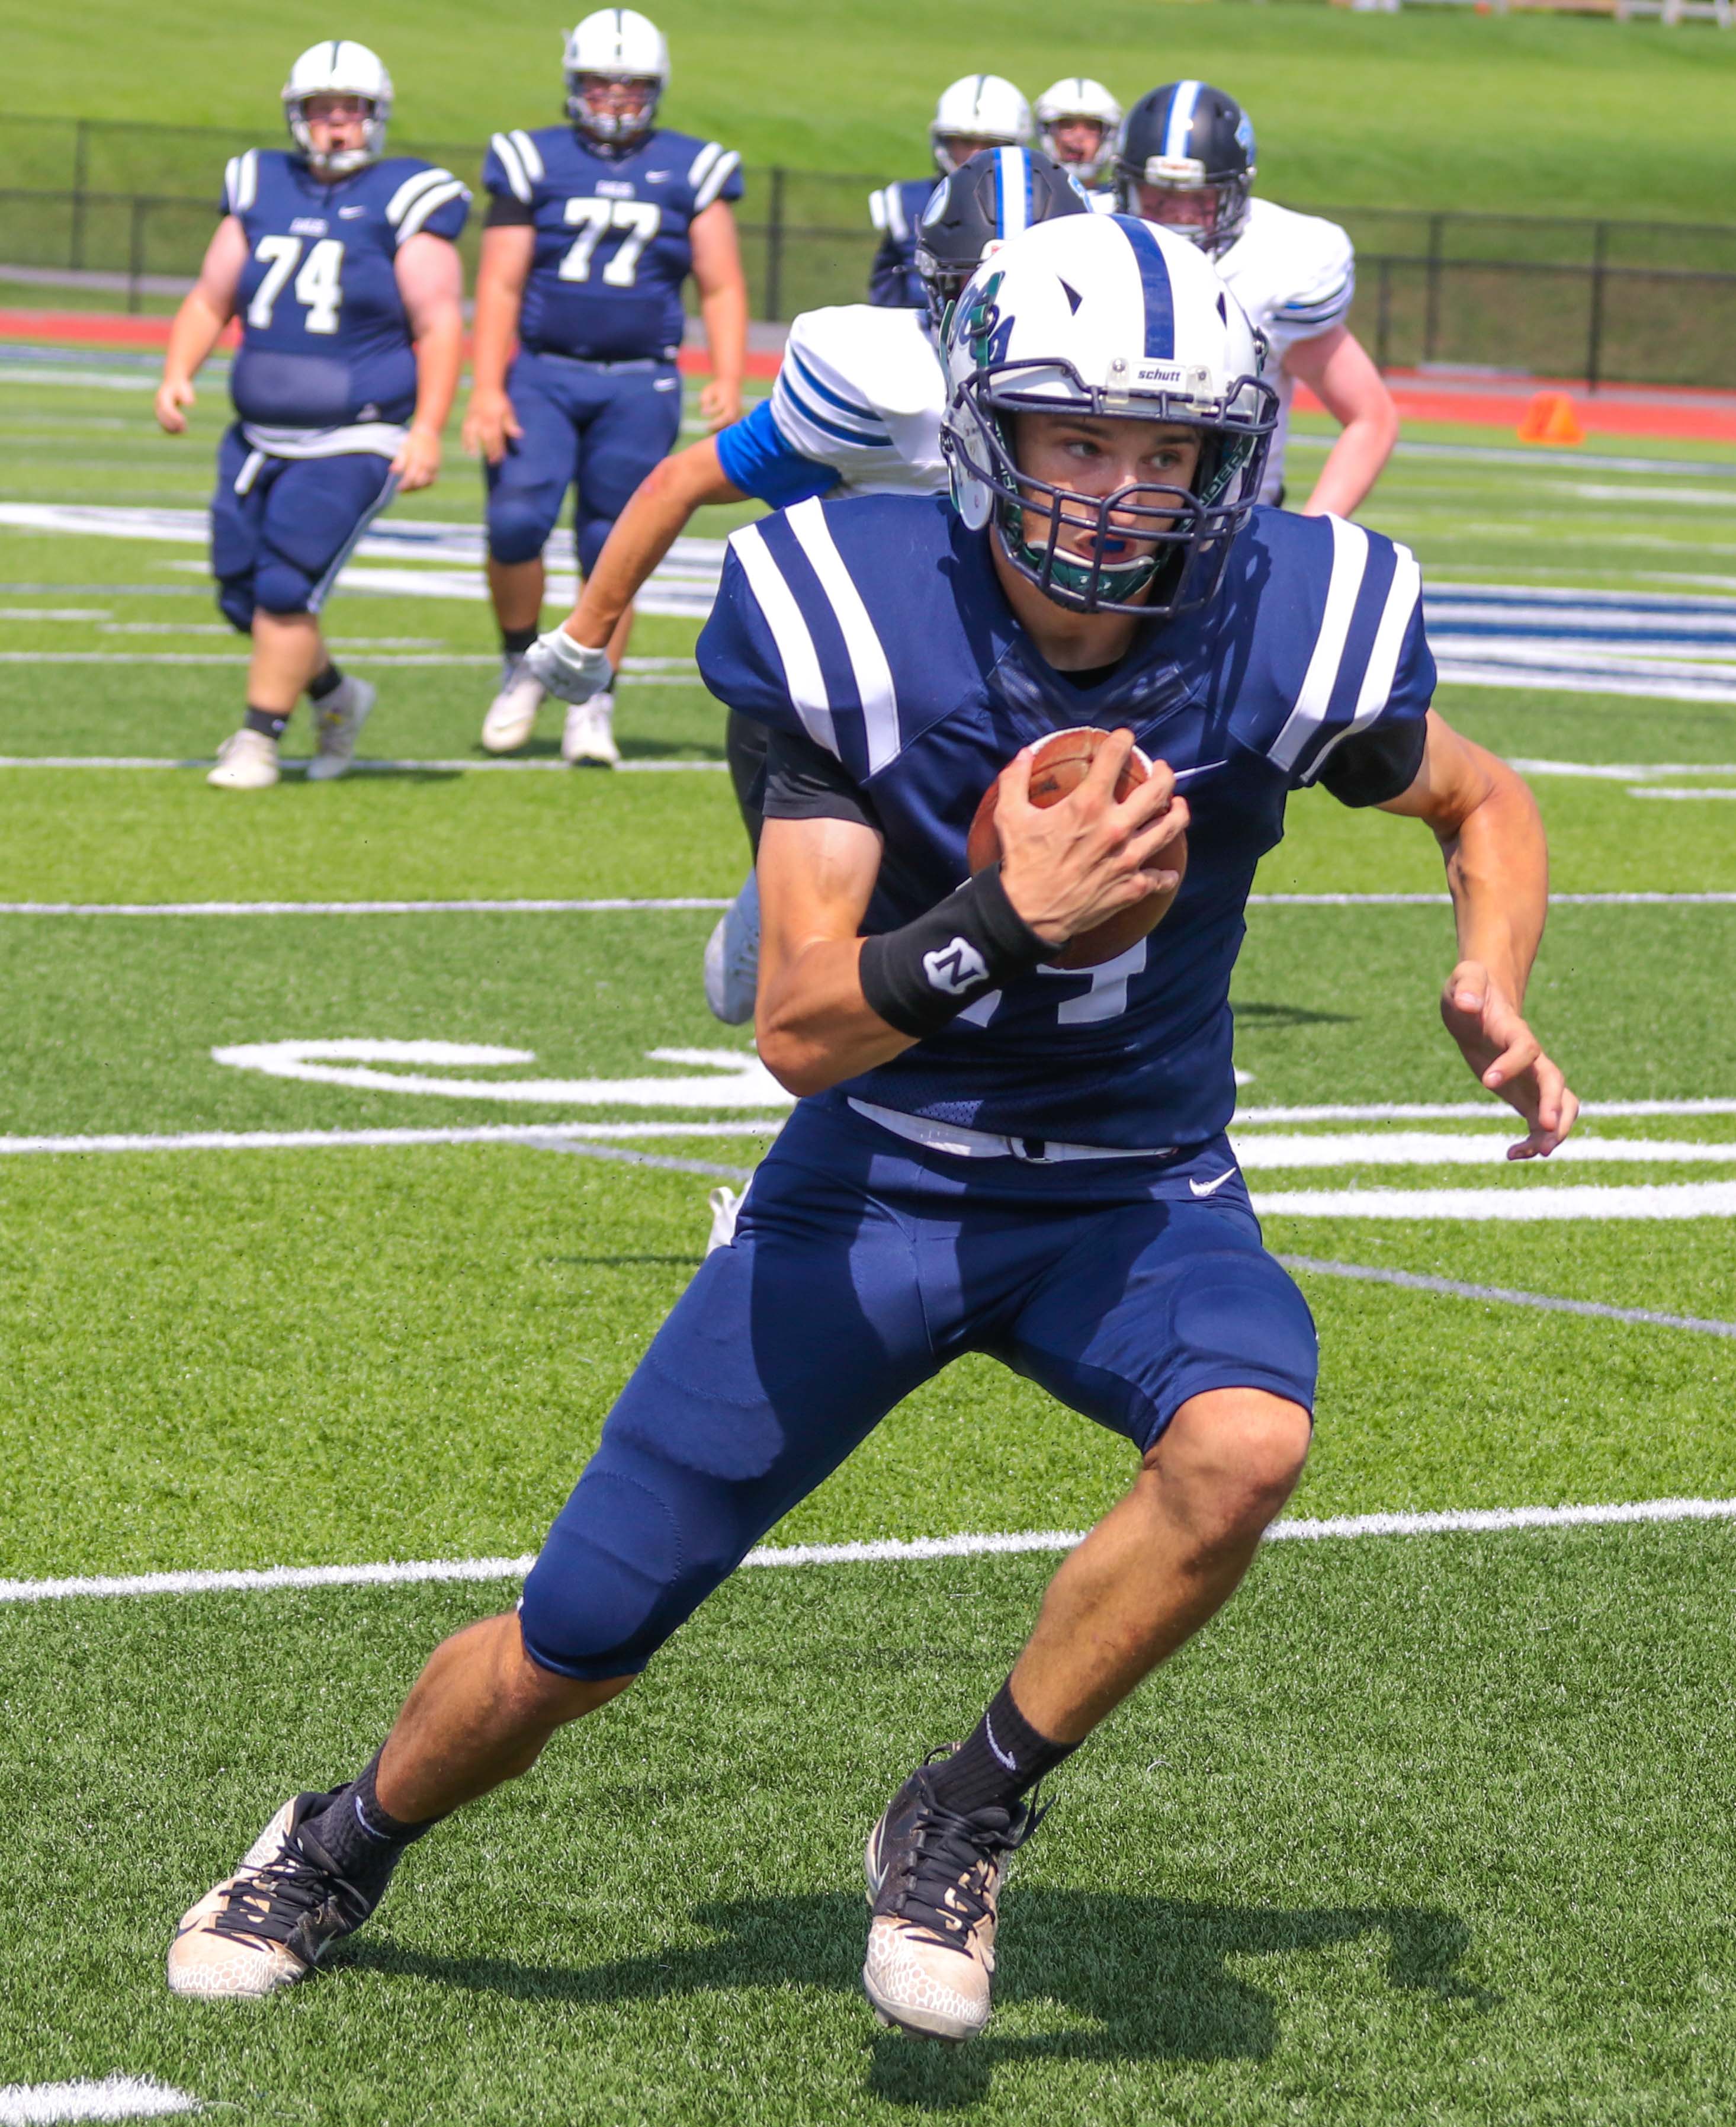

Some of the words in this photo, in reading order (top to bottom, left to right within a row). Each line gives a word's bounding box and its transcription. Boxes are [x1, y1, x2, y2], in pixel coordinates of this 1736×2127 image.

[559, 197, 661, 287] 77
[248, 235, 344, 334] 74
[1138, 367, 1180, 381] schutt
[931, 947, 981, 988] N
